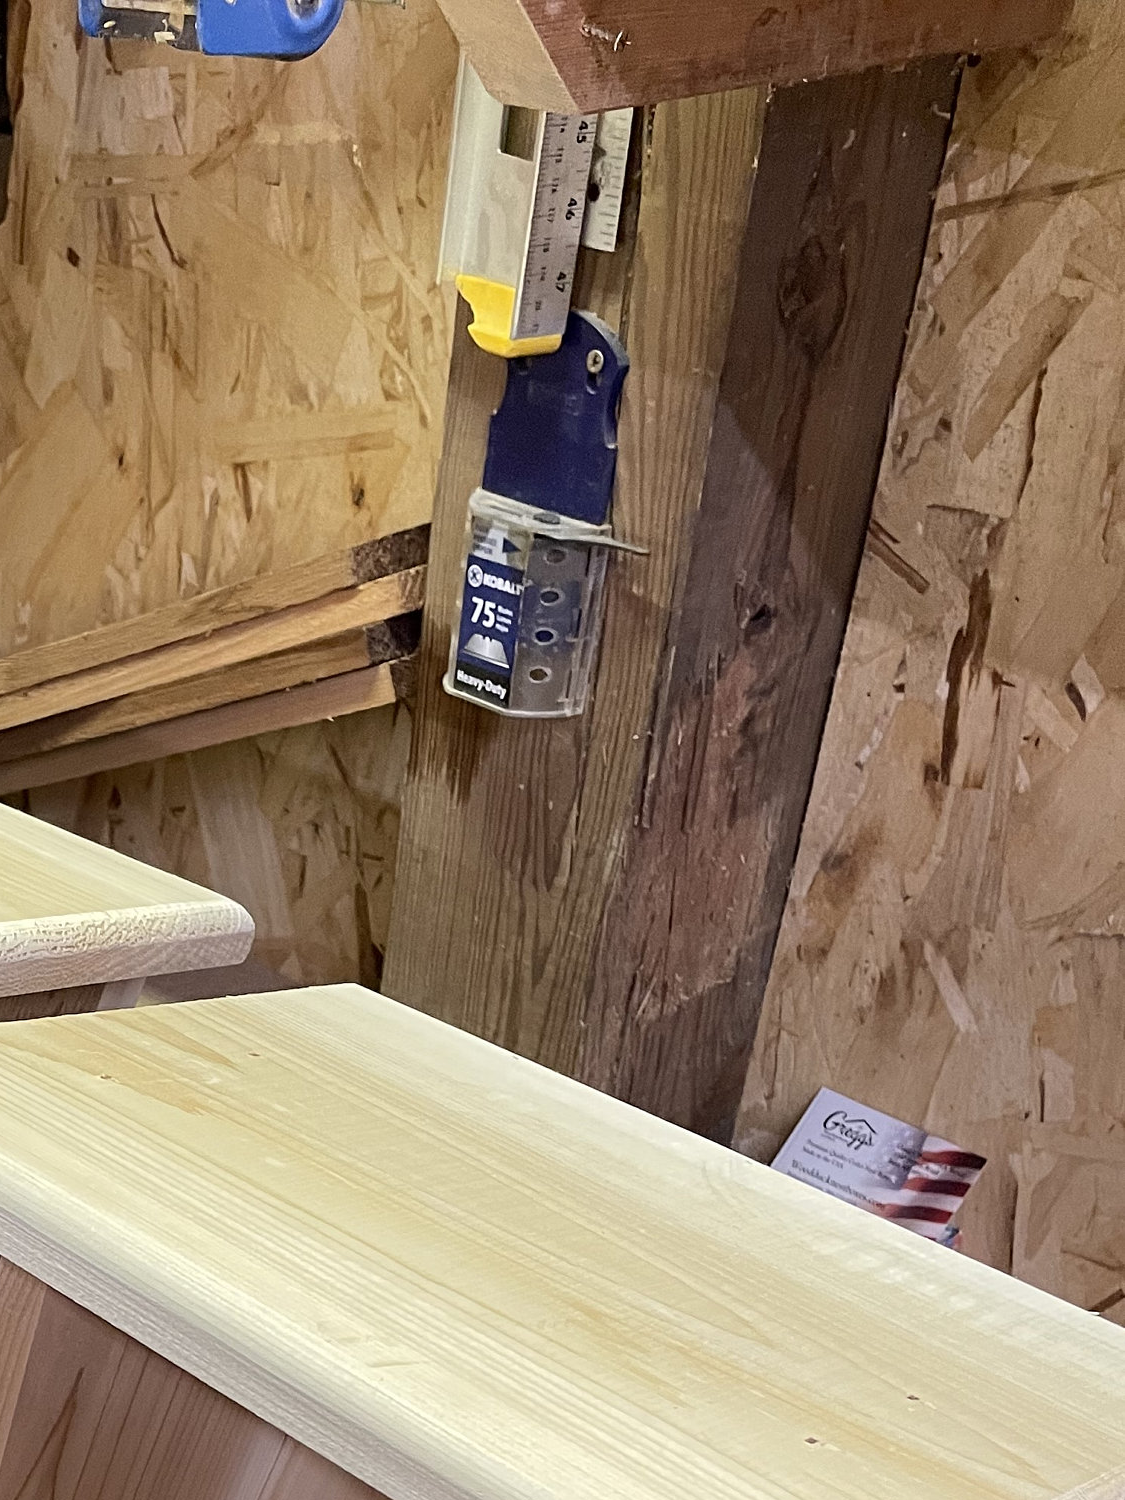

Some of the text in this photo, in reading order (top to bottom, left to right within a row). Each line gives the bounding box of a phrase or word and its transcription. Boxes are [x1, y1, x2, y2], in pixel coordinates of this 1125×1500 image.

[577, 121, 588, 143] 45
[566, 198, 577, 220] 46
[555, 272, 566, 293] 47
[483, 572, 523, 596] KOBALT
[471, 596, 496, 628] 75
[457, 669, 507, 700] Heavy-Duty
